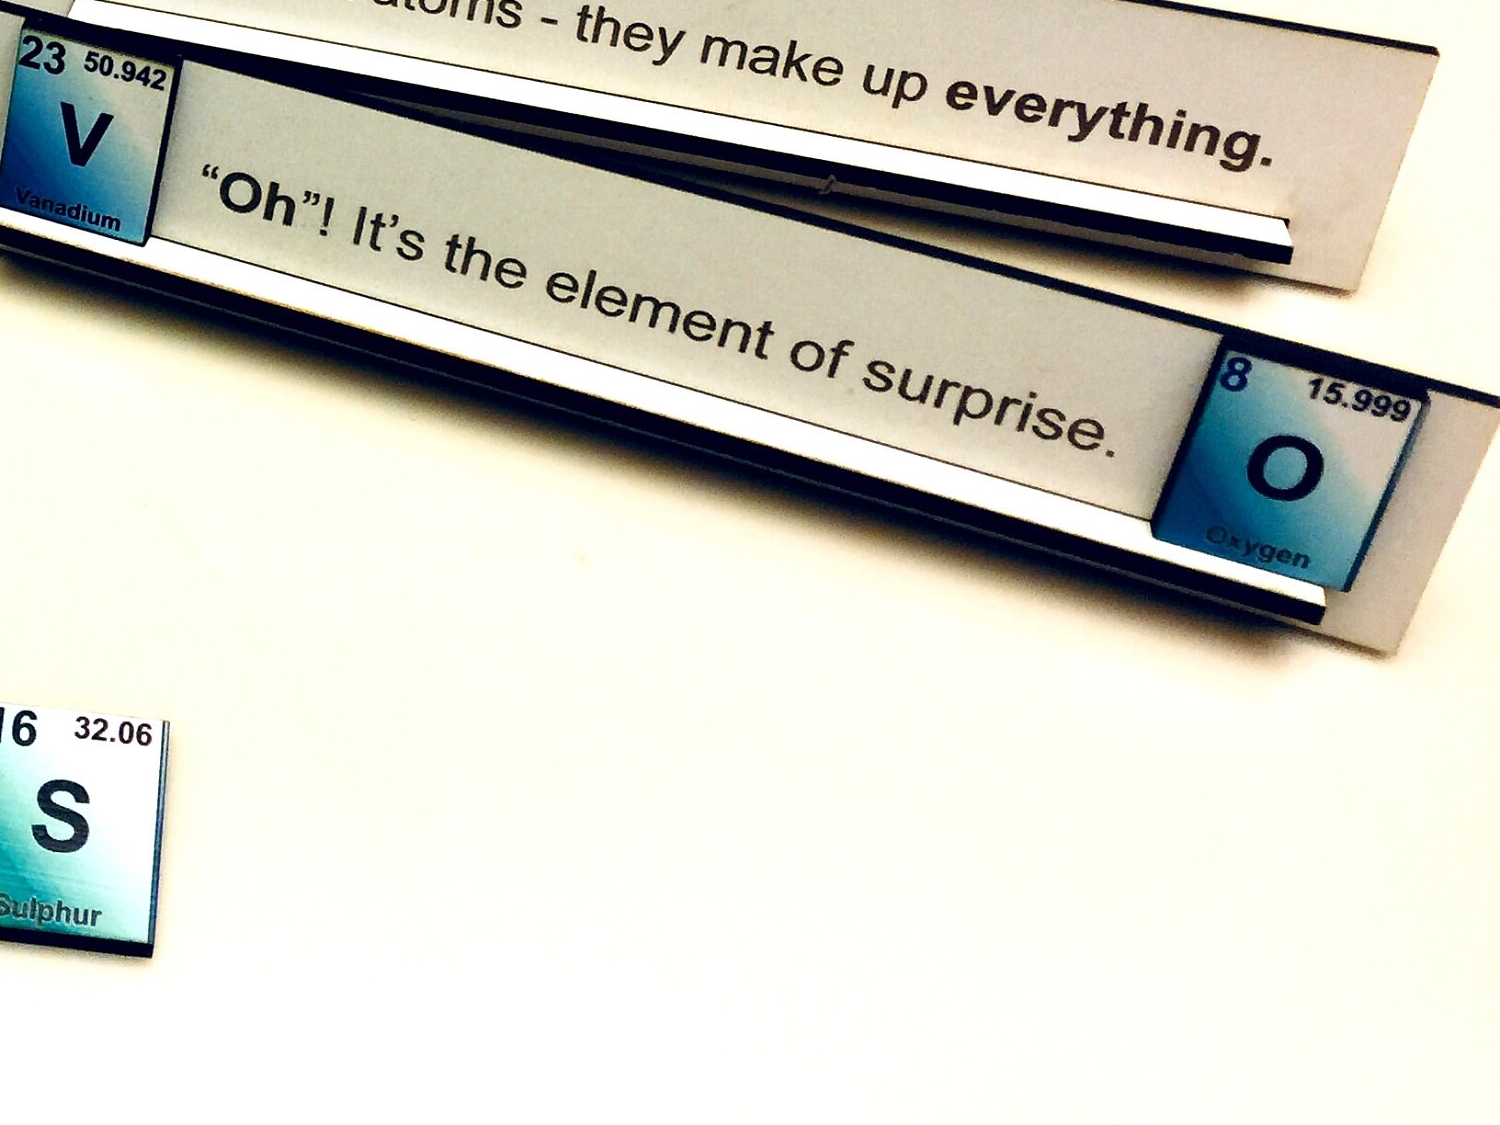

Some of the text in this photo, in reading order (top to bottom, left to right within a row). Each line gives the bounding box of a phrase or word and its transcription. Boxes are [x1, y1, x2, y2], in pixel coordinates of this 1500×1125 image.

[19, 35, 167, 91] 23 50.942
[576, 4, 686, 67] they
[701, 33, 844, 87] make
[862, 61, 928, 111] up
[946, 74, 1273, 171] everything.
[60, 101, 112, 167] V
[14, 185, 121, 233] Vanadium
[202, 163, 1116, 459] “Oh”! It’s the element of surprise.
[1220, 356, 1412, 423] 8 15.999
[1247, 435, 1324, 502] O
[1204, 523, 1311, 570] Oxygen
[74, 716, 153, 748] 32.06
[32, 778, 90, 853] S
